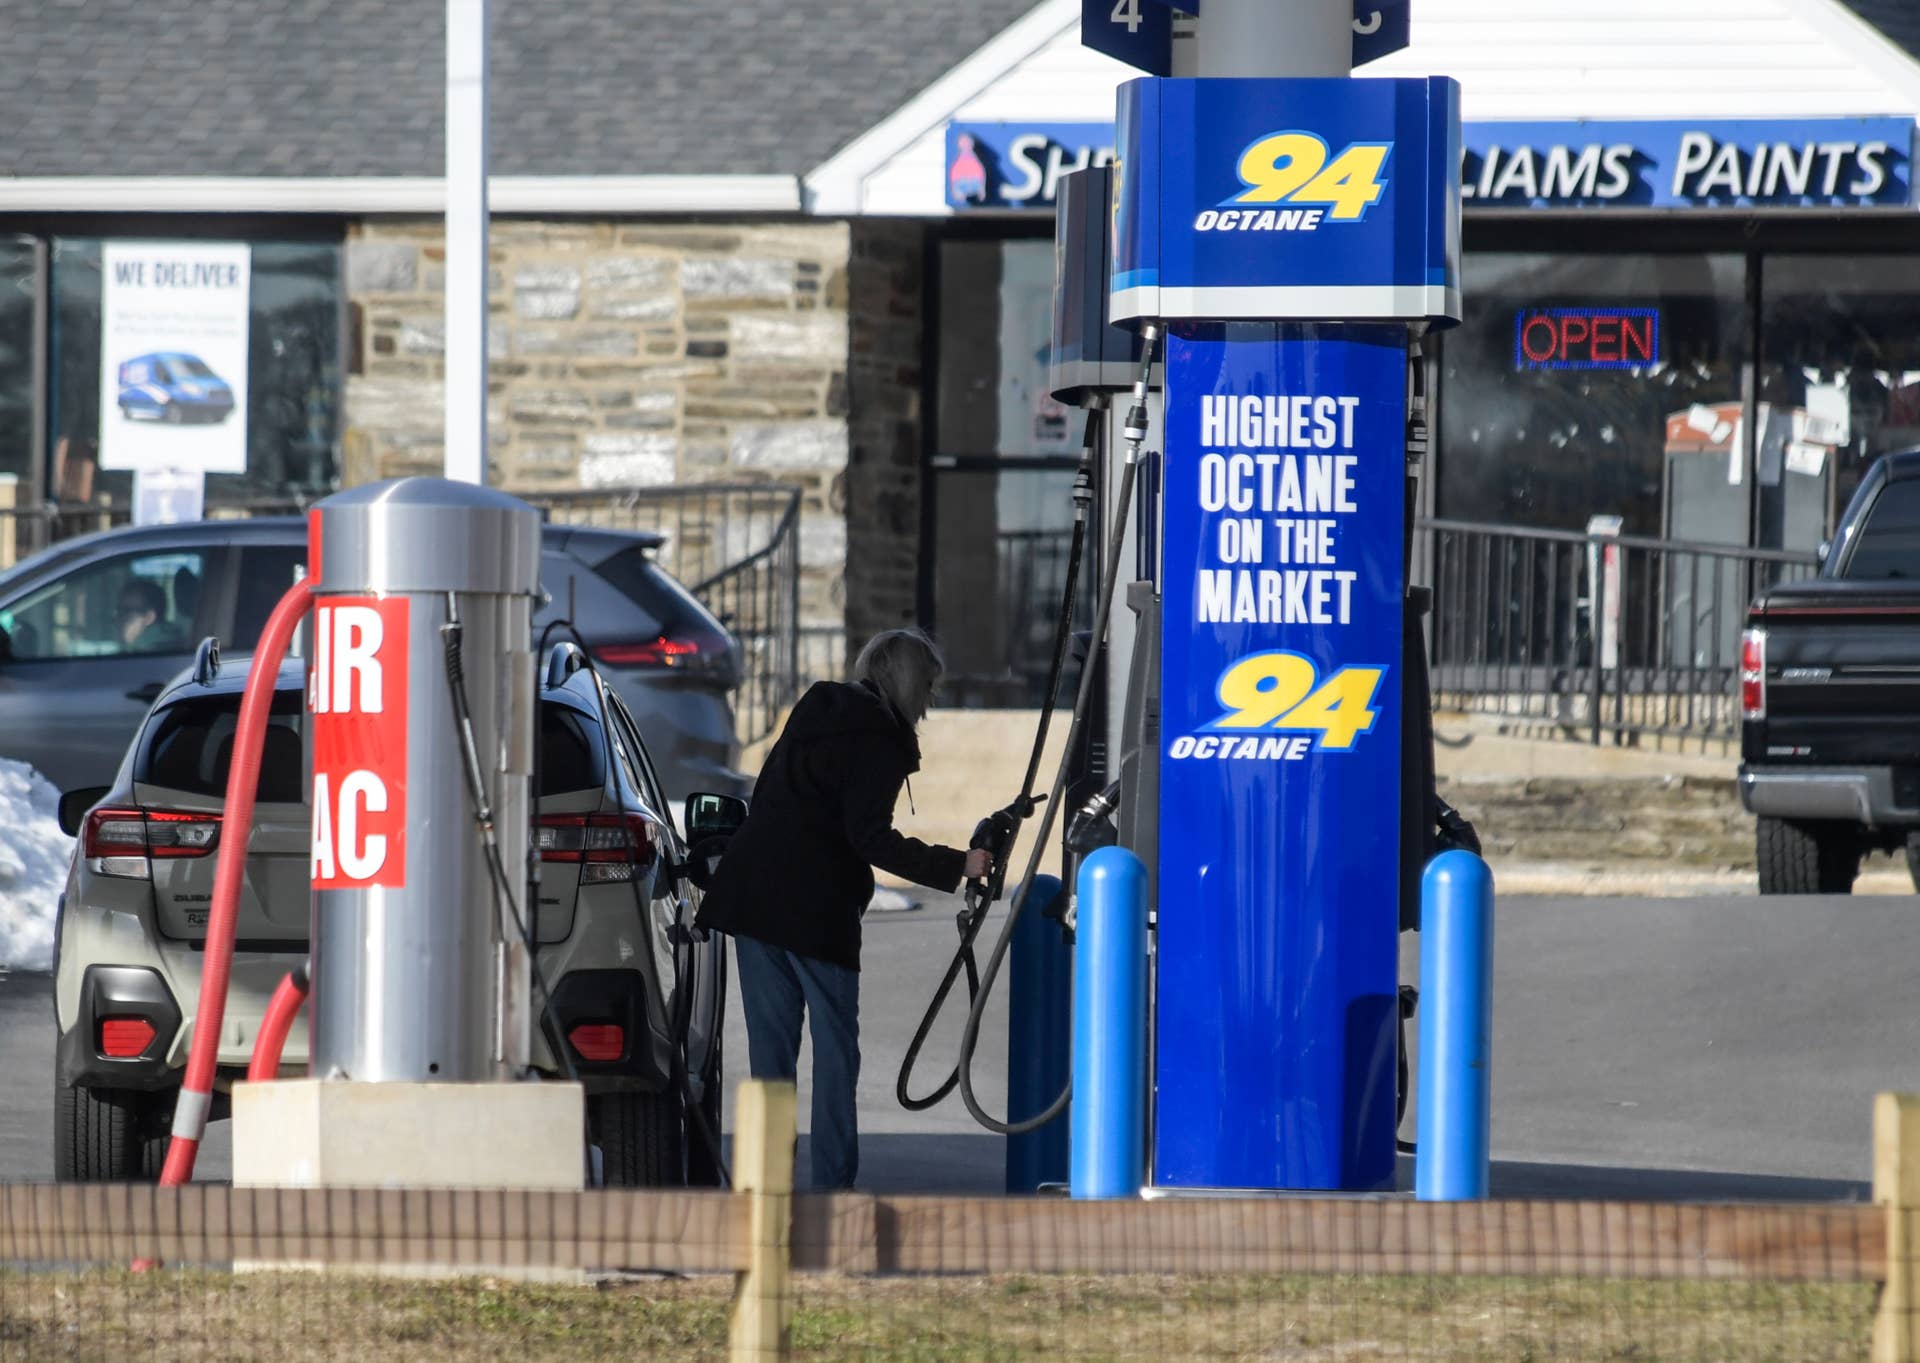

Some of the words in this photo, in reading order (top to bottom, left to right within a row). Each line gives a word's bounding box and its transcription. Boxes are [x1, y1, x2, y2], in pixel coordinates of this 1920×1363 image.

[1230, 131, 1391, 220] 94
[1672, 132, 1888, 197] PAINTS
[1195, 209, 1324, 232] OCTANE
[114, 261, 146, 288] WE
[154, 262, 240, 289] DELIVER
[1522, 315, 1653, 362] OPEN
[1202, 395, 1360, 448] HIGHEST
[1201, 453, 1358, 513] OCTANE
[1219, 518, 1263, 564] ON
[1276, 519, 1337, 564] THE
[1200, 569, 1357, 624] MARKET
[1215, 653, 1384, 748] 94
[1170, 736, 1312, 761] OCTANE
[311, 769, 388, 880] AC
